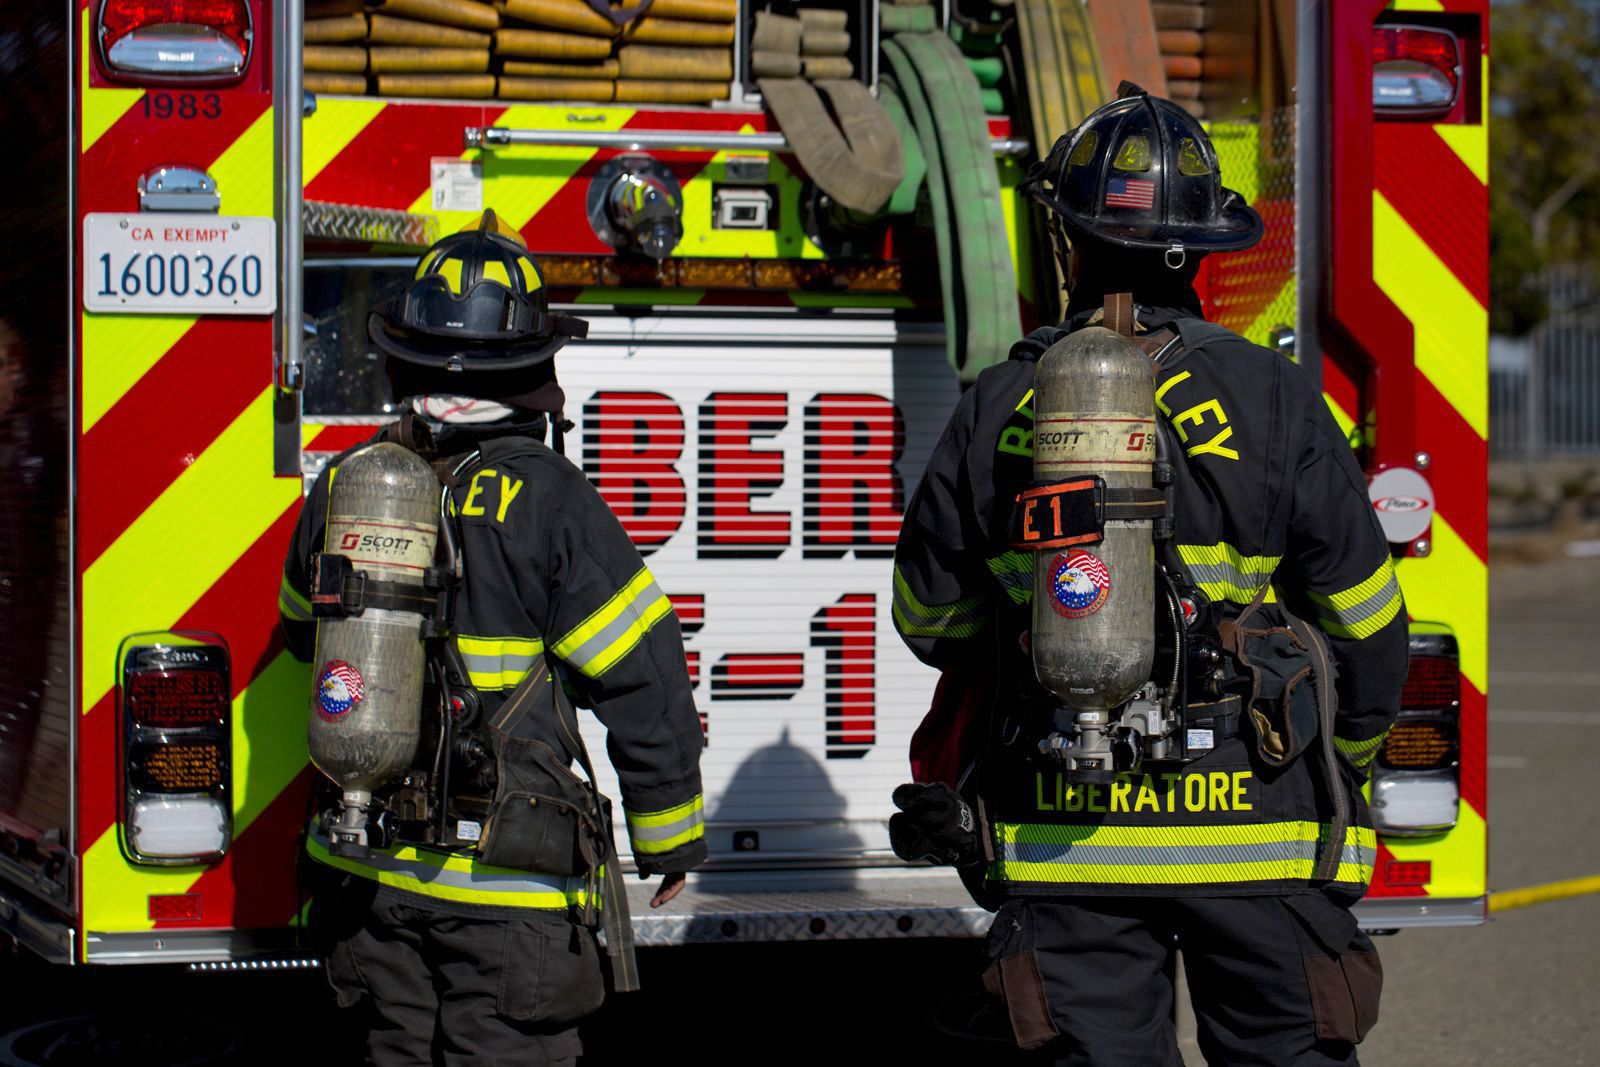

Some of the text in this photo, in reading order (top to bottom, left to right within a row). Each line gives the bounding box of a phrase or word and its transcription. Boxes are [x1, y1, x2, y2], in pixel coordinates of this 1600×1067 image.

[143, 93, 222, 119] 1983
[131, 227, 229, 243] CA EXEMPT
[97, 252, 262, 297] 1600360
[1037, 432, 1083, 445] SCOTT
[450, 469, 524, 523] EY
[361, 535, 413, 551] SCOTT
[664, 593, 877, 759] -1
[1036, 771, 1253, 813] LIBERATORE
